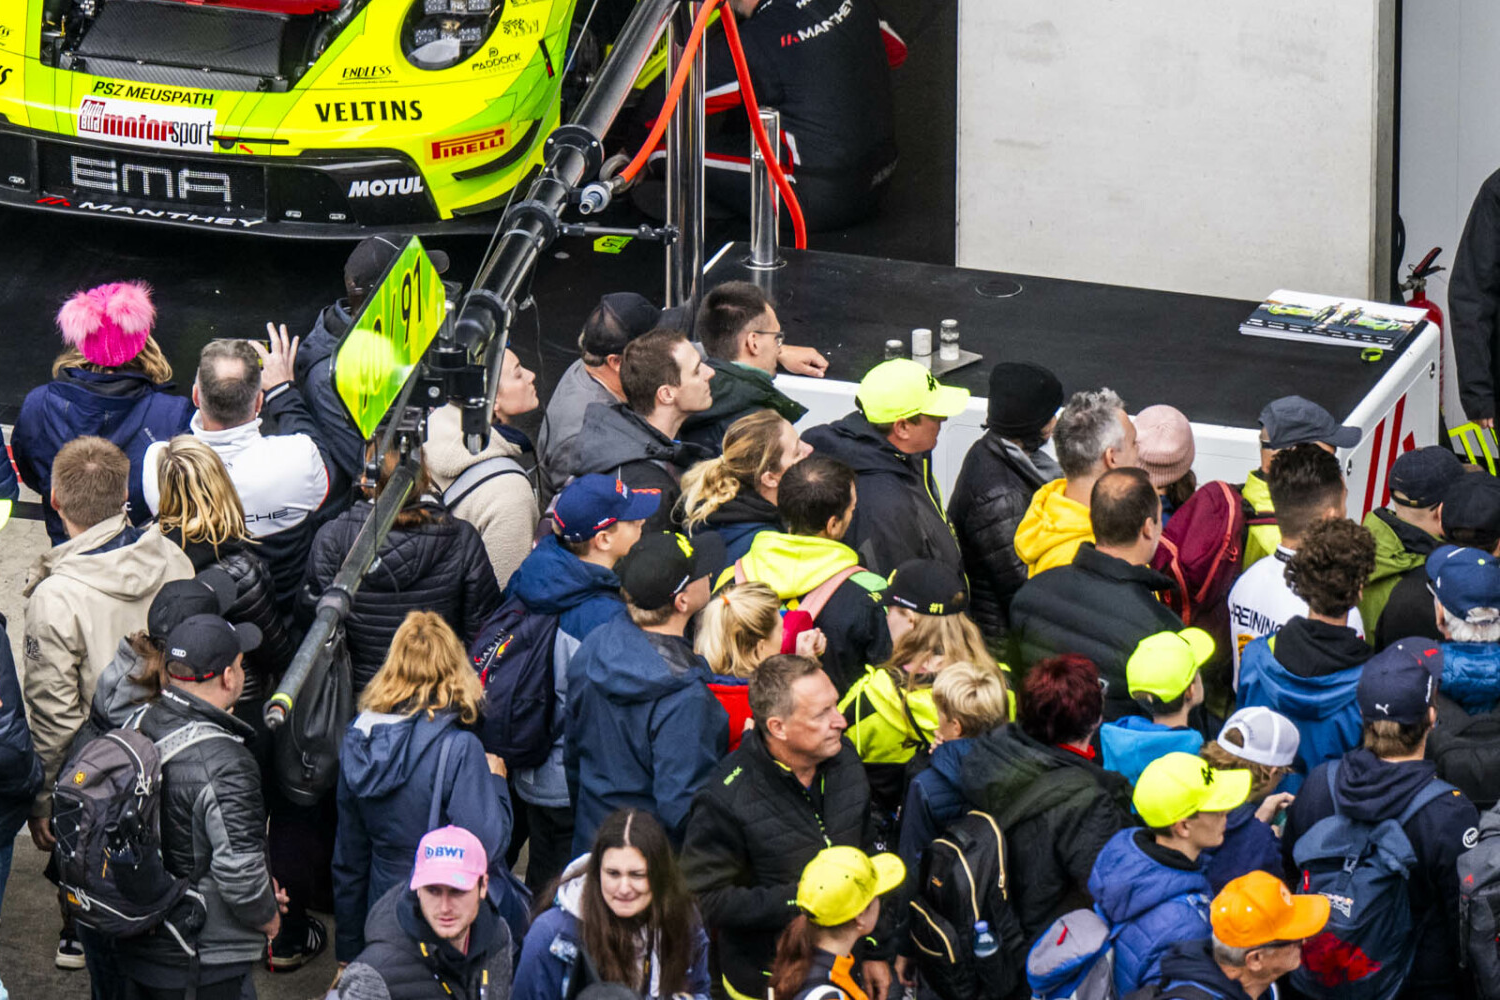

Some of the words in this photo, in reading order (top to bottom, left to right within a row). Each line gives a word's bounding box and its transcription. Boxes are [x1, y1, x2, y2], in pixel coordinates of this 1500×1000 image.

[341, 65, 392, 79] ENDLESS
[471, 52, 522, 72] PADDOCK
[92, 80, 124, 96] PSZ
[125, 86, 215, 106] MEUSPATH
[314, 99, 423, 123] VELTINS
[103, 114, 213, 146] motorsport
[431, 127, 505, 161] PIRELLI
[71, 155, 232, 203] EMA
[348, 176, 424, 198] MOTUL
[78, 200, 264, 228] MANTHEY
[929, 602, 944, 615] #1
[435, 846, 465, 859] BWT
